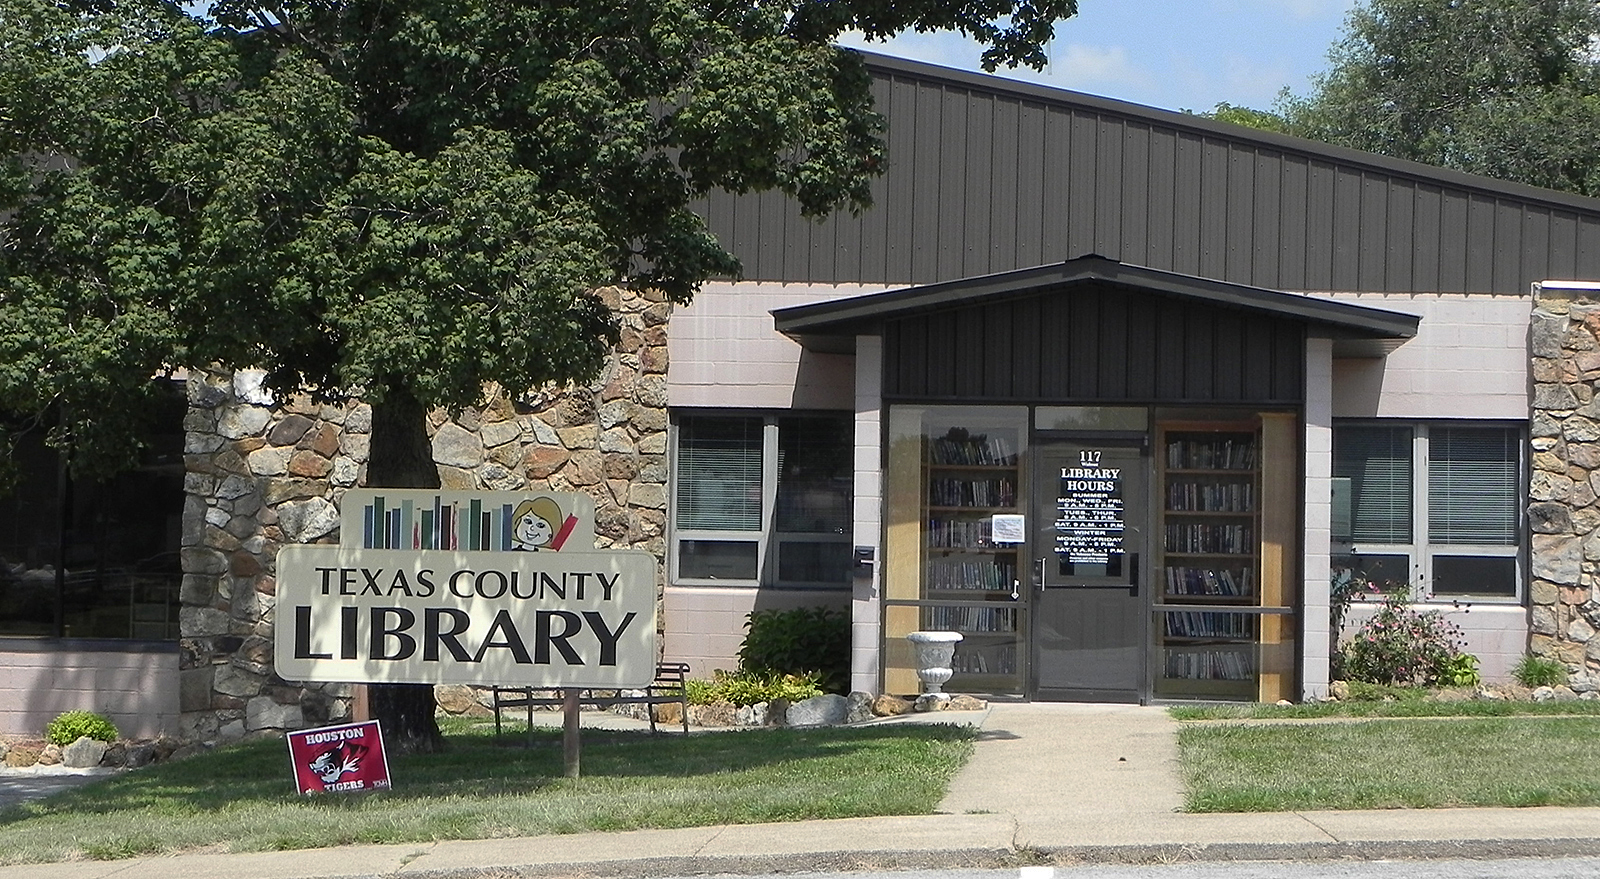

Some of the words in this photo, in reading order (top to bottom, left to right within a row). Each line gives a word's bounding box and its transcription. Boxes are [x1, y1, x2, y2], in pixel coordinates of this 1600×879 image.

[1080, 450, 1101, 462] 117
[1061, 468, 1120, 479] LIBRARY
[1067, 480, 1114, 491] HOURS
[315, 567, 434, 598] TEXAS
[448, 569, 621, 601] COUNTY
[294, 605, 637, 666] LIBRARY
[305, 727, 364, 745] HOUSTON
[324, 779, 365, 792] TIGERS
